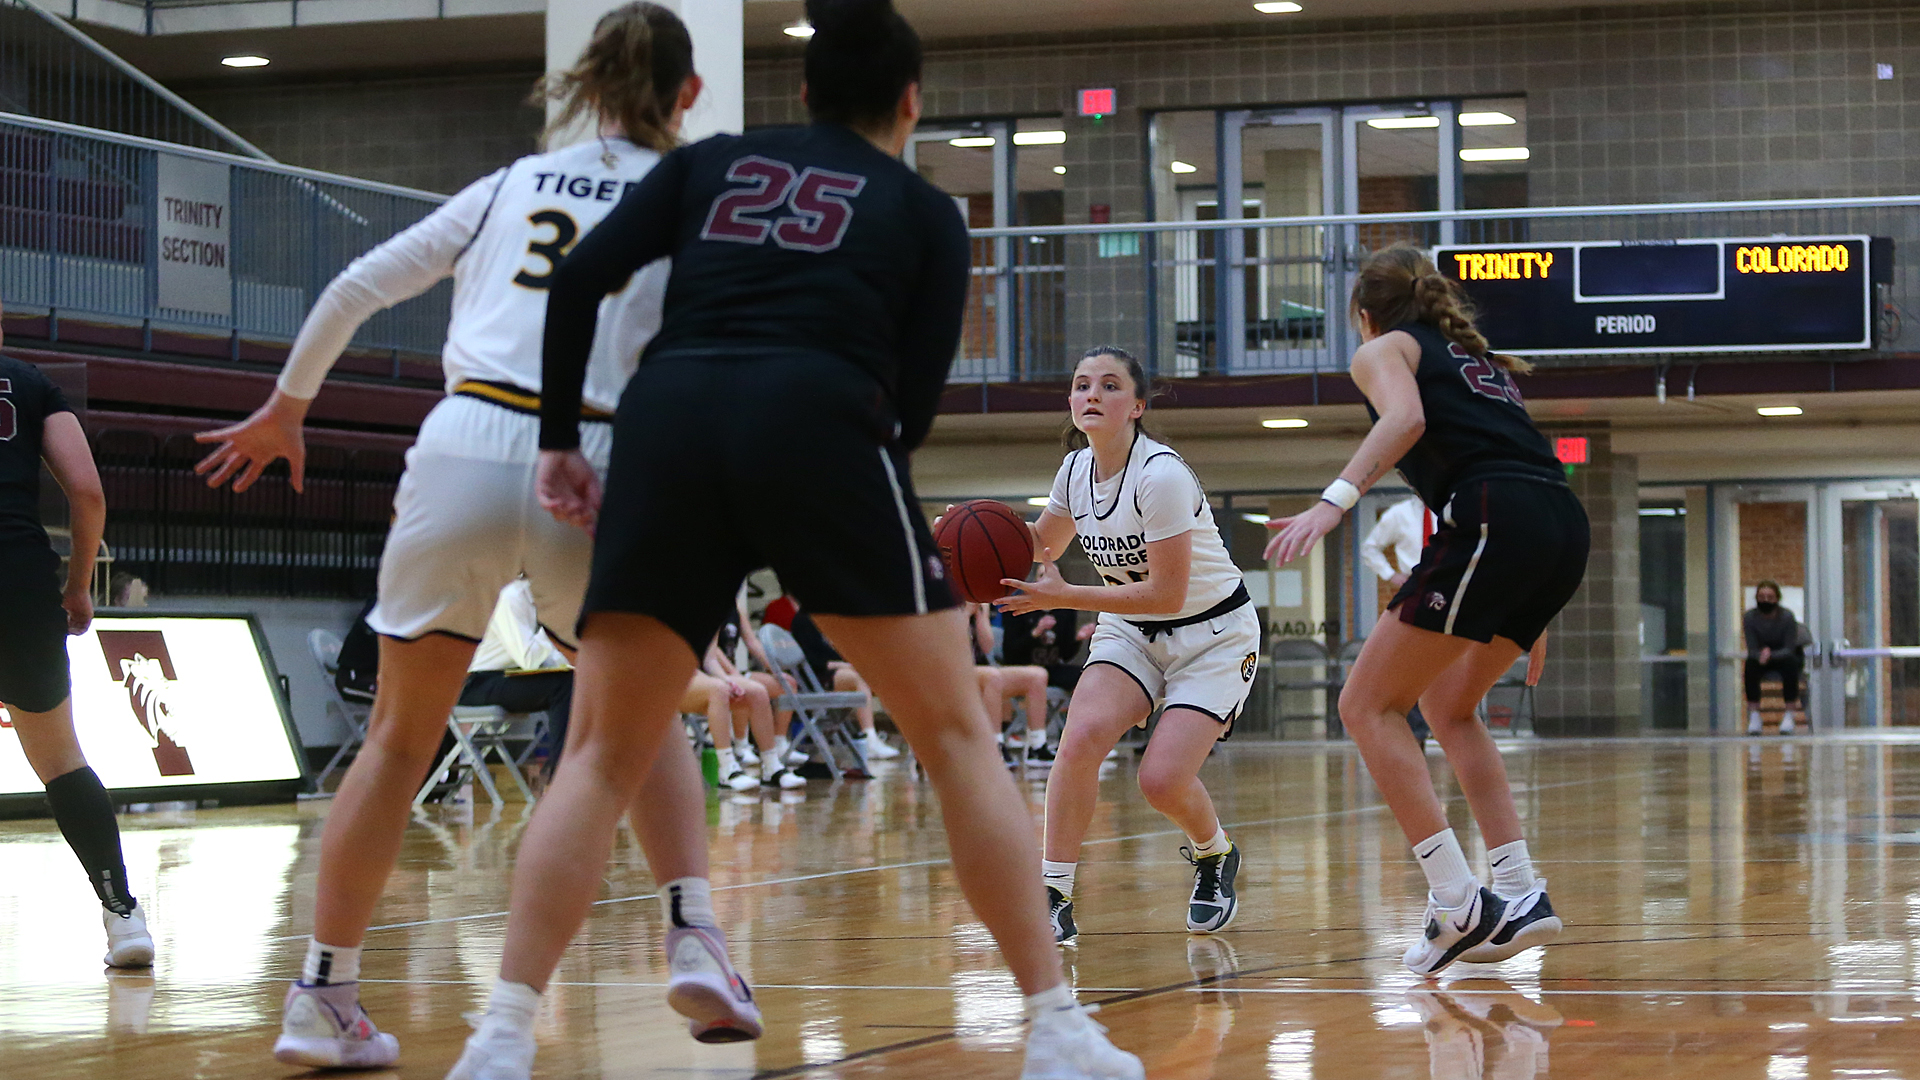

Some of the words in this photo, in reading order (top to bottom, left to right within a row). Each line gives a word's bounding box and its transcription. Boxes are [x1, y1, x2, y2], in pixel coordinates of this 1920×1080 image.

[164, 197, 223, 229] TRINITY
[700, 155, 867, 253] 25
[162, 236, 225, 268] SECTION
[1453, 252, 1554, 280] TRINITY
[1735, 245, 1849, 274] COLORADO
[1595, 315, 1656, 334] PERIOD
[1076, 531, 1147, 552] OLORAD
[1086, 549, 1148, 567] OLLEGE
